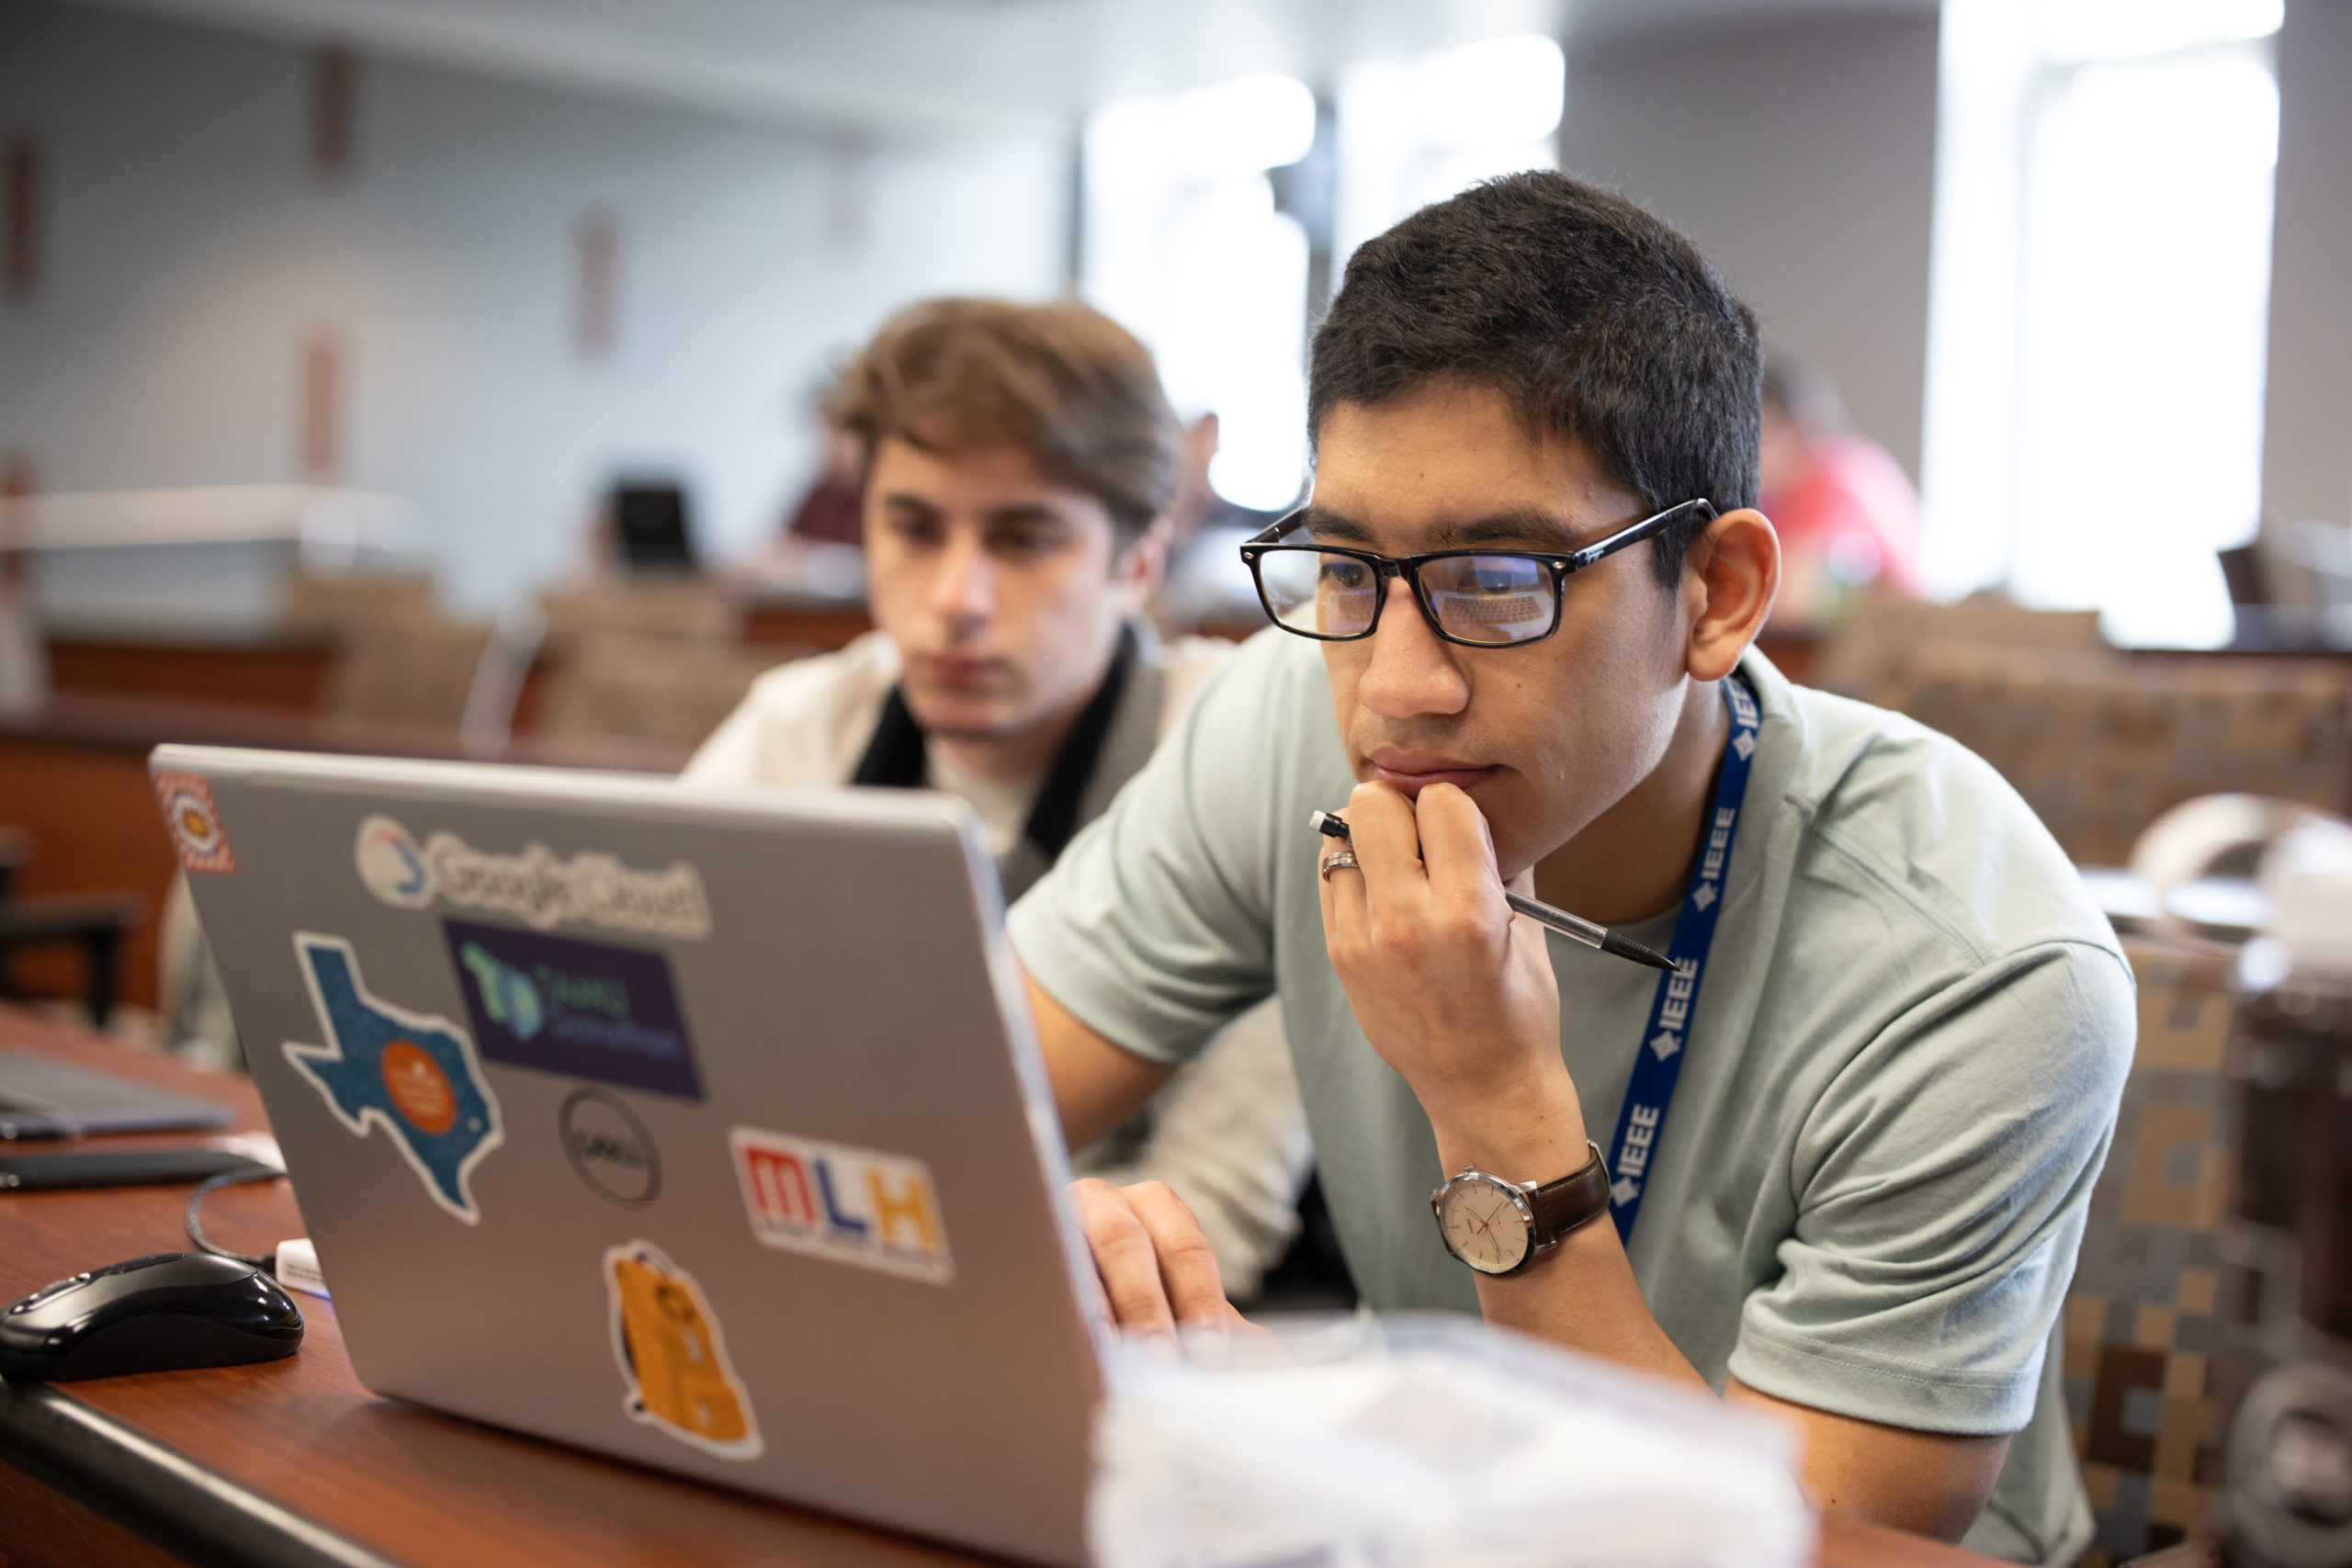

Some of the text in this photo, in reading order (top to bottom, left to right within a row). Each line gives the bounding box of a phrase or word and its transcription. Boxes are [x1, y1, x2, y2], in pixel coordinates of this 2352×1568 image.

[432, 840, 571, 915] Google
[1702, 807, 1736, 880] IEEE
[1658, 956, 1699, 1031] IEEE
[1617, 1103, 1660, 1177] IEEE
